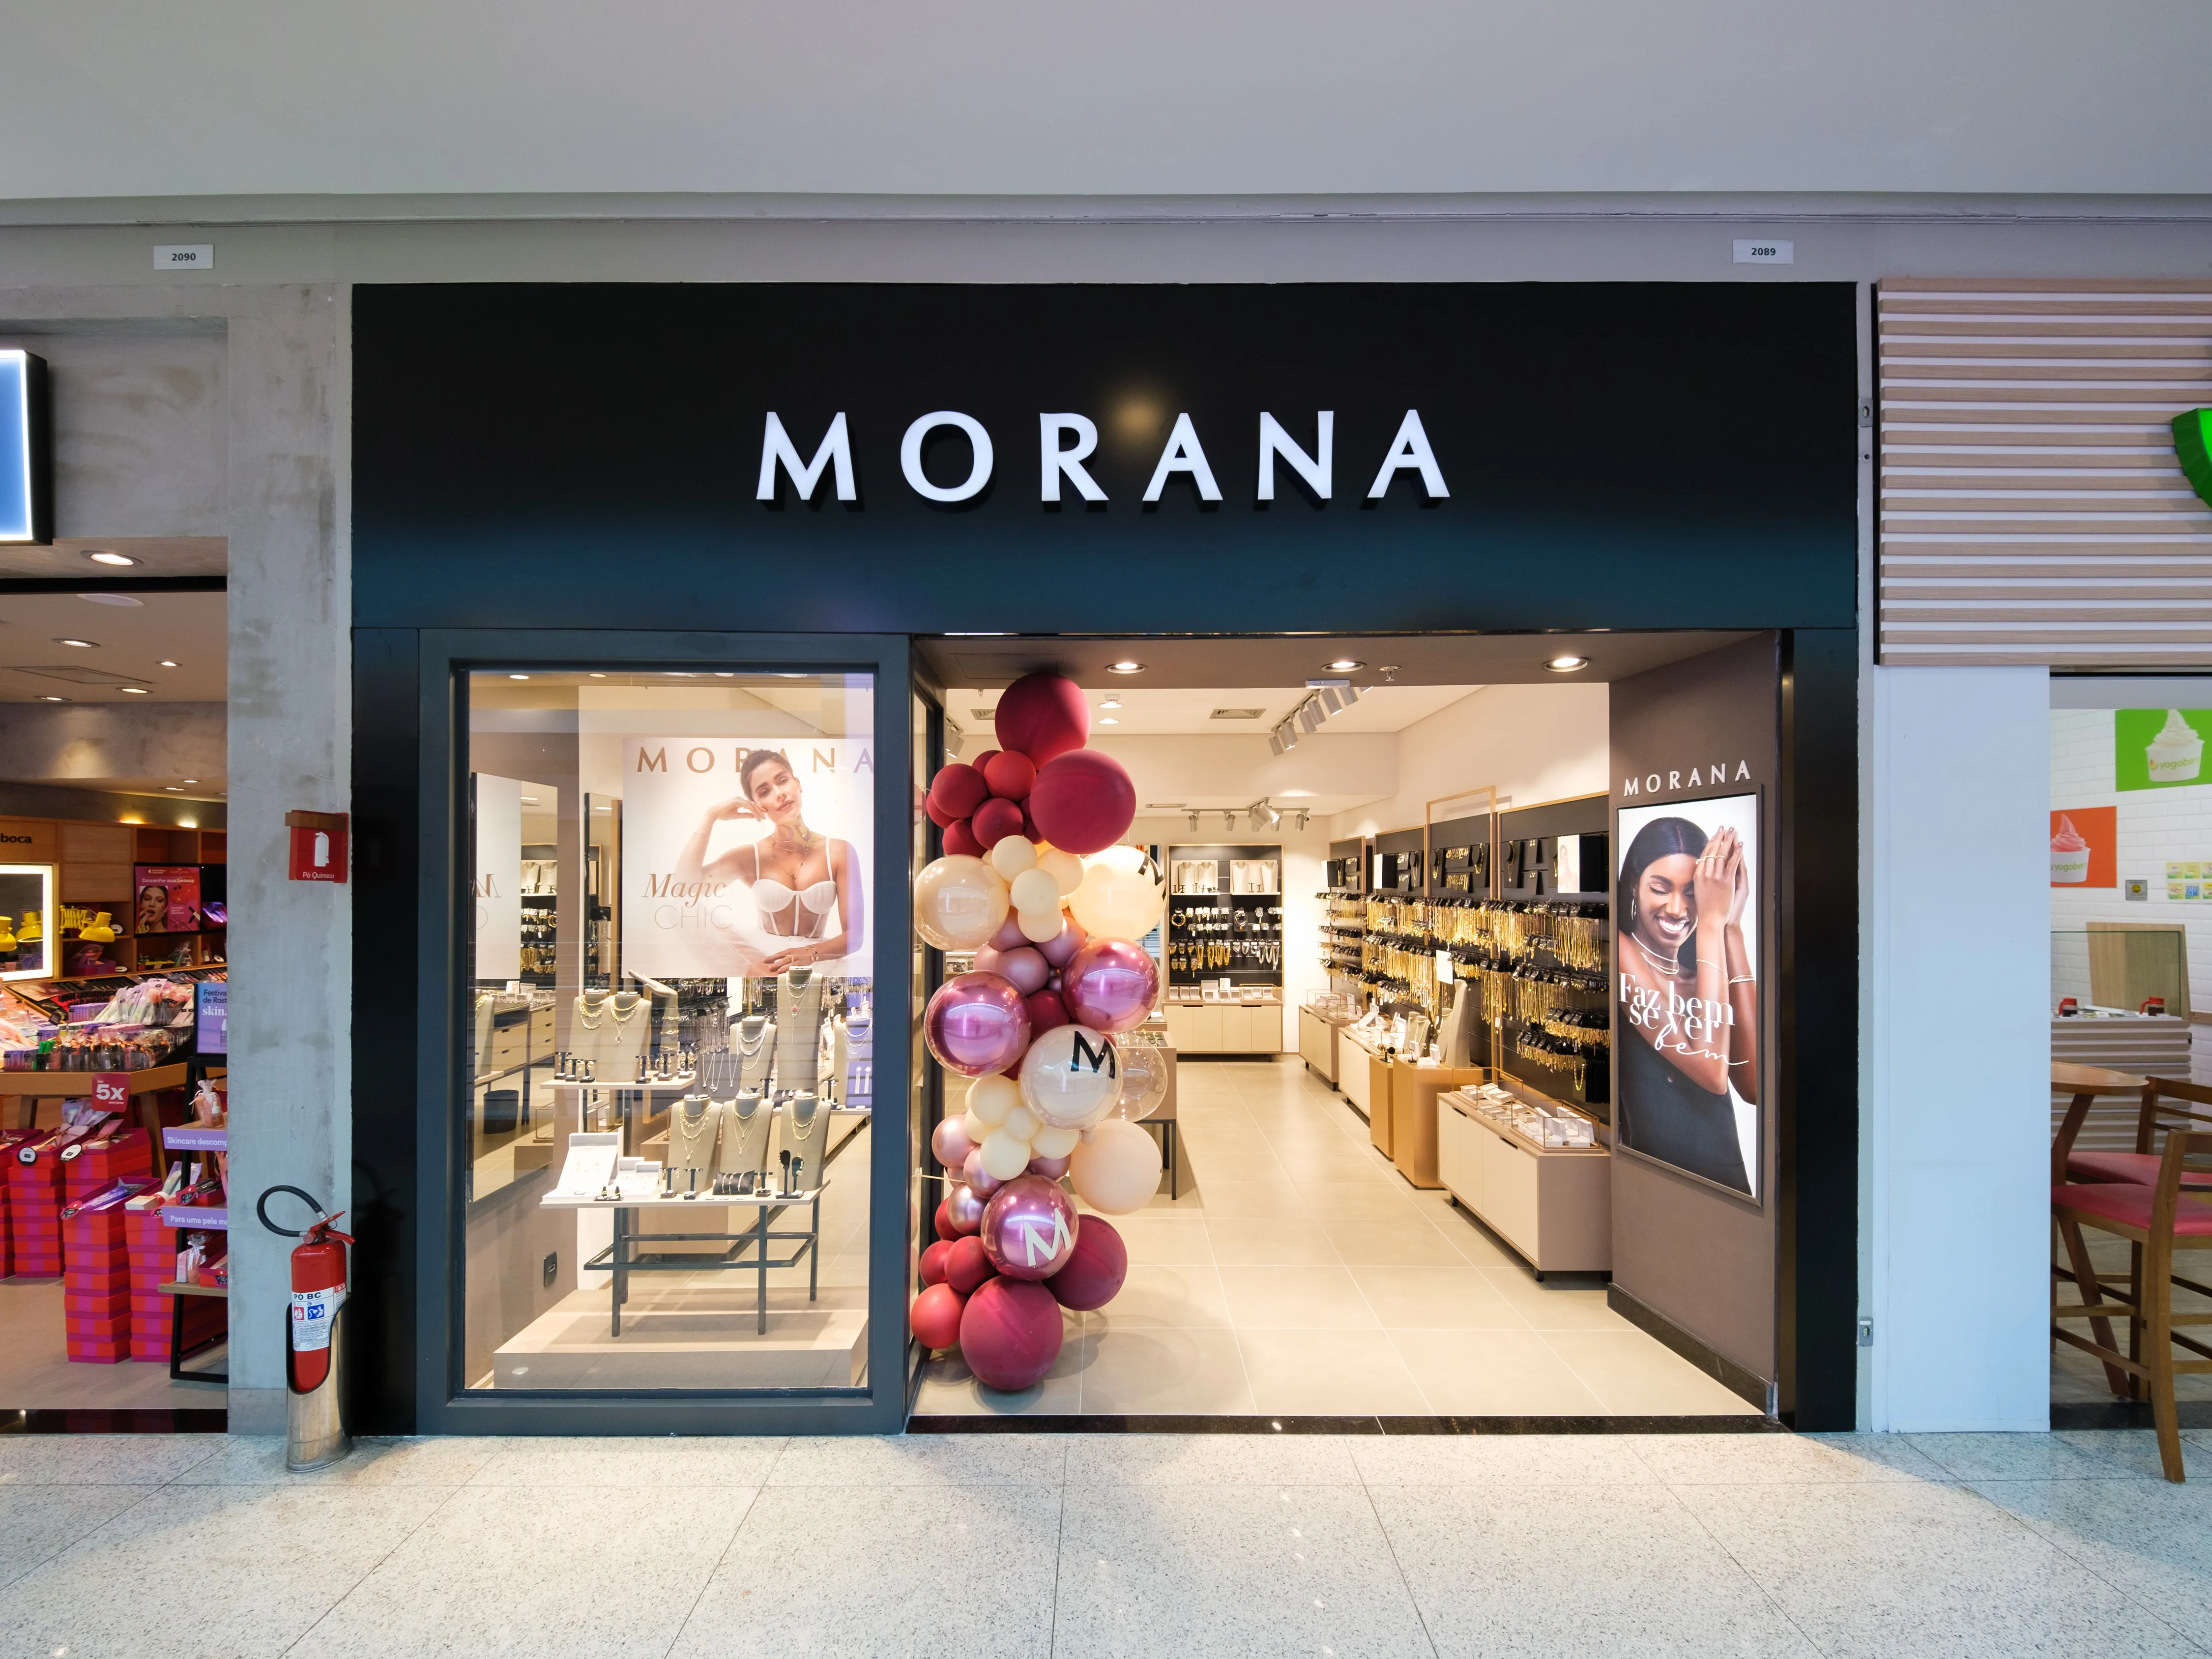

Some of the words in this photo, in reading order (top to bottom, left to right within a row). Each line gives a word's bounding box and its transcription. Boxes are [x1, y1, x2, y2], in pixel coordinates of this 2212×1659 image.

[172, 253, 196, 261] 2090
[1751, 247, 1776, 256] 2089
[756, 409, 1451, 502] MORANA
[1624, 759, 1751, 796] MORANA
[0, 833, 32, 844] boca
[641, 873, 727, 908] Magic
[655, 905, 733, 930] CHIC
[1619, 972, 1661, 1011] Faz
[1668, 980, 1736, 1026] bem
[1630, 1003, 1659, 1030] se
[1665, 1011, 1720, 1044] ver
[1071, 1031, 1116, 1079] M
[1655, 1024, 1749, 1065] bem
[96, 1084, 125, 1100] 5x
[167, 1136, 196, 1145] Skincare
[1023, 1207, 1072, 1267] M
